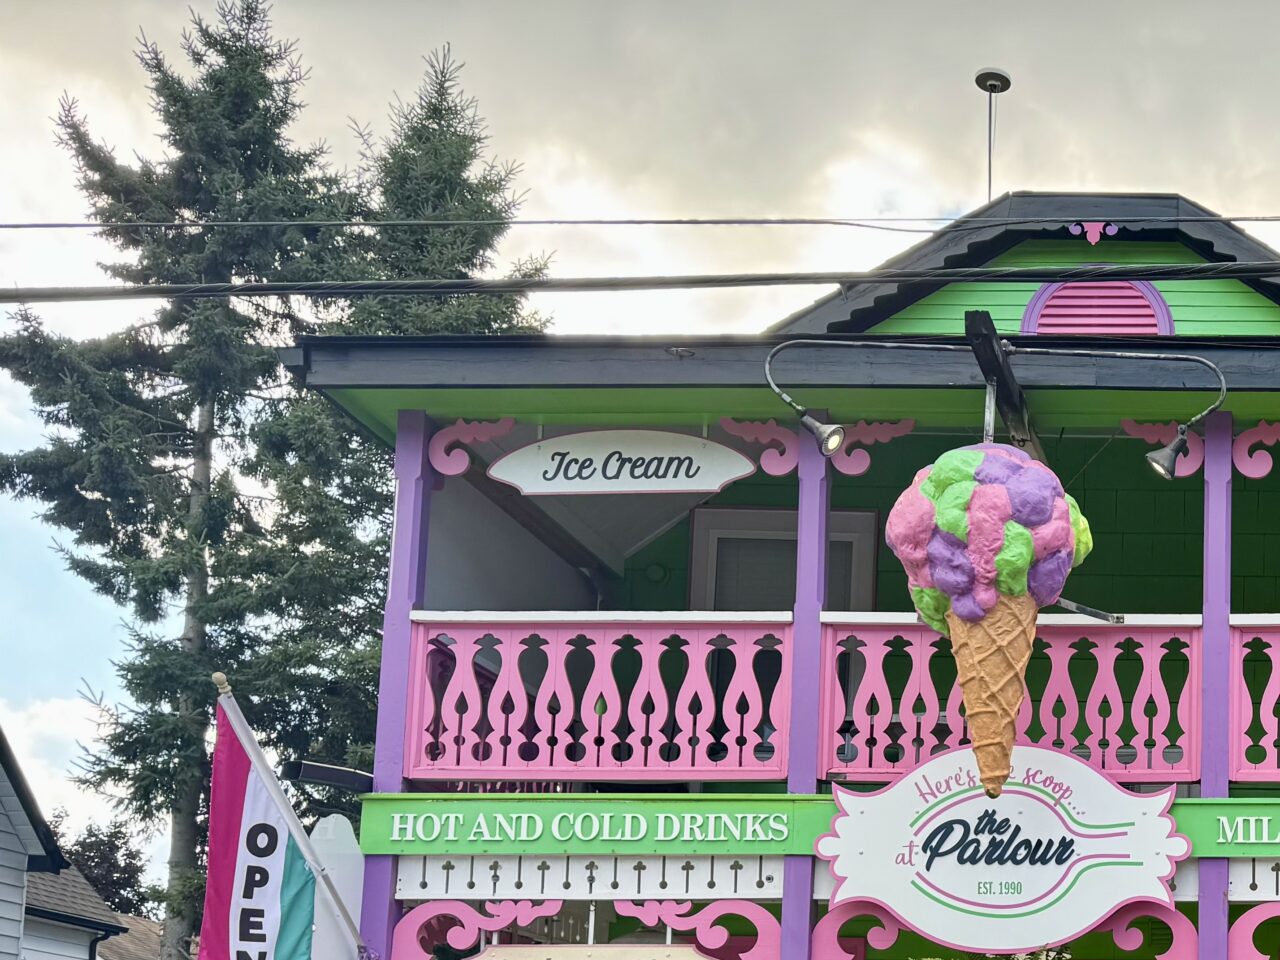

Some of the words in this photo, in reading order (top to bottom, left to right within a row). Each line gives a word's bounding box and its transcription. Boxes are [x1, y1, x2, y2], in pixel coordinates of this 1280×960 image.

[542, 451, 597, 482] Ice
[601, 450, 701, 480] Cream
[914, 766, 977, 804] Here's
[389, 813, 464, 842] HOT
[467, 813, 544, 842] AND
[550, 812, 648, 842] COLD
[653, 812, 790, 843] DRINKS
[974, 809, 1011, 836] the
[895, 840, 920, 866] at
[921, 818, 1076, 873] Parlour
[977, 881, 996, 895] EST.
[998, 881, 1023, 895] 1990
